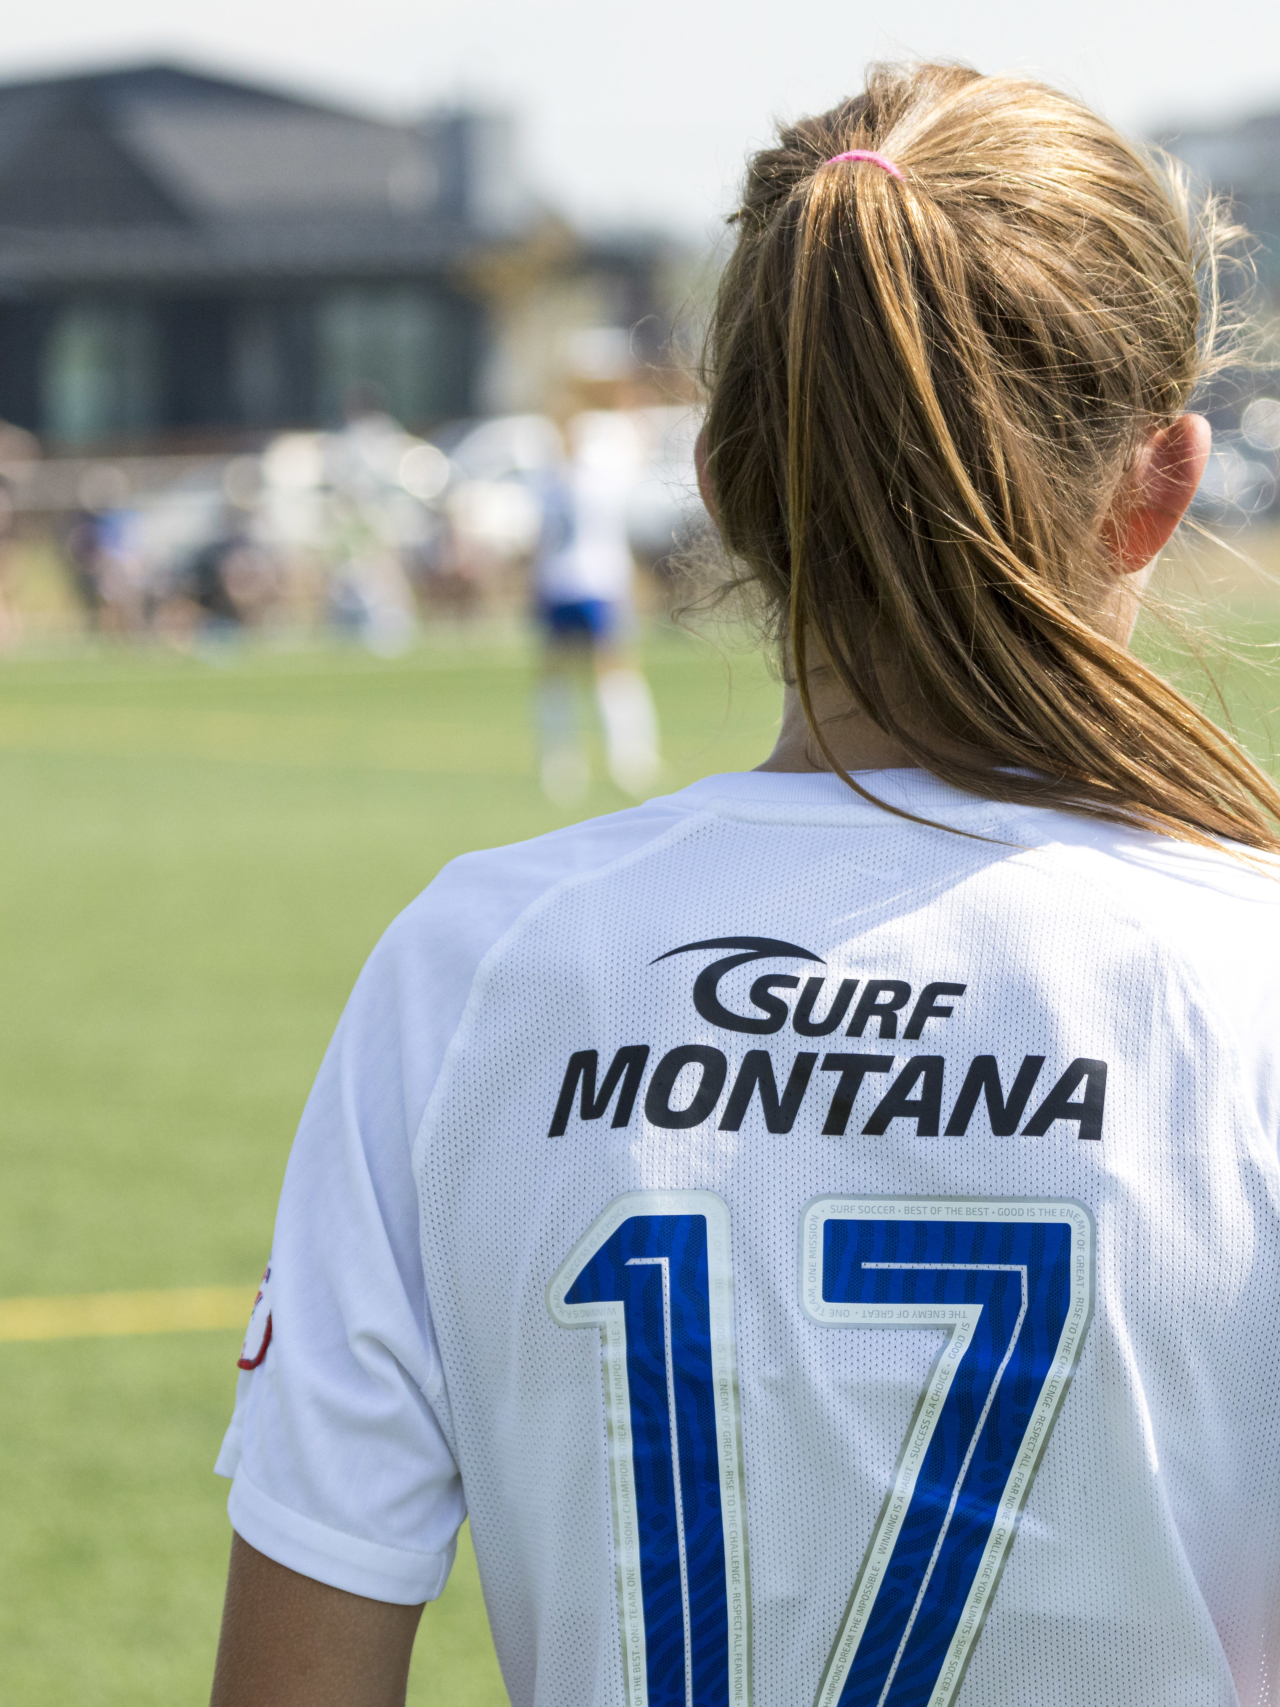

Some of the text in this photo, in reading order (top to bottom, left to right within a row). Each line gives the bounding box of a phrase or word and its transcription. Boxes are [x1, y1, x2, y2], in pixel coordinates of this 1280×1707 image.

[748, 973, 967, 1040] SURF
[547, 1043, 1108, 1141] MONTANA
[829, 1204, 896, 1215] SURF SOCCER
[903, 1205, 990, 1217] BEST OF THE BEST
[564, 1204, 628, 1282] SUCCESS IS A CHOICE
[809, 1214, 819, 1260] MISSION
[997, 1207, 1086, 1288] GOOD IS THE ENEMY OF GREAT
[808, 1263, 818, 1283] ONE
[829, 1308, 850, 1318] ONE
[861, 1309, 970, 1360] GOOD IS THE ENEMY OF GREAT
[611, 1330, 623, 1391] IMPOSSIBLE
[718, 1355, 728, 1378] THE
[1041, 1297, 1084, 1409] RISE TO THE CHALLENGE
[615, 1392, 624, 1412] THE
[719, 1379, 730, 1413] ENEMY
[910, 1415, 931, 1460] SUCCESS
[924, 1408, 935, 1418] IS
[931, 1368, 950, 1401] CHOICE
[721, 1415, 731, 1430] OF
[1027, 1414, 1046, 1453] RESPECT
[560, 1210, 1076, 1707] 17
[722, 1431, 733, 1463] GREAT
[618, 1454, 631, 1514] CHAMPIONS
[1010, 1472, 1025, 1495] FEAR
[724, 1470, 741, 1585] RISE TO THE CHALLENGE
[877, 1513, 899, 1555] WINNING
[894, 1504, 902, 1514] IS
[900, 1466, 914, 1495] HABIT
[1001, 1496, 1016, 1521] NONE
[623, 1521, 634, 1564] MISSION
[626, 1566, 636, 1587] ONE
[962, 1527, 1006, 1635] CHALLENGE YOUR LIMITS
[630, 1622, 640, 1643] ONE
[732, 1592, 742, 1631] RESPECT
[822, 1565, 880, 1707] HAMPIONS DREAM THE IMPOSSIBLE
[632, 1650, 643, 1707] OF THE BEST
[734, 1653, 743, 1676] FEAR
[939, 1638, 966, 1692] SURF SOCCER
[734, 1678, 743, 1701] NONE
